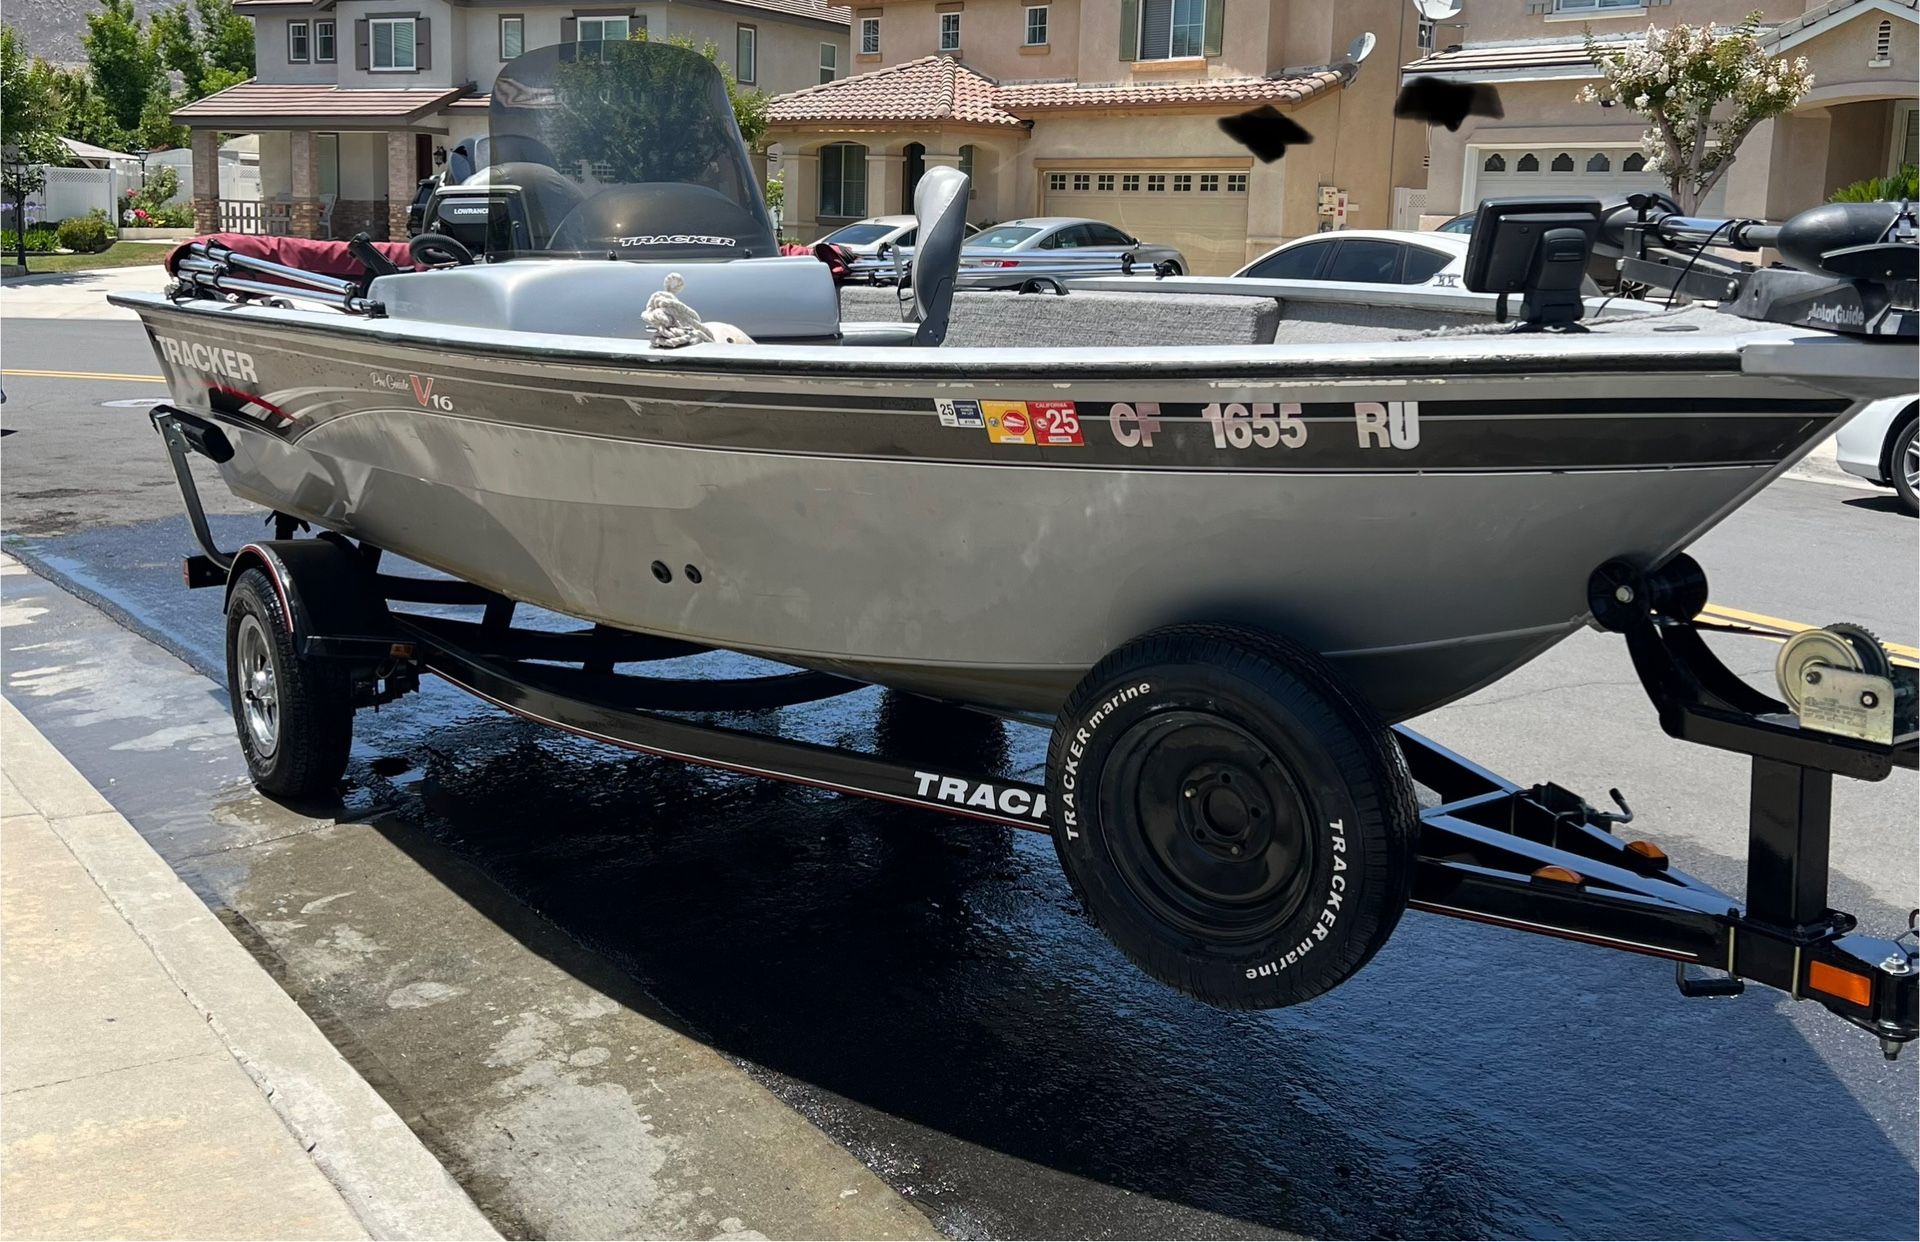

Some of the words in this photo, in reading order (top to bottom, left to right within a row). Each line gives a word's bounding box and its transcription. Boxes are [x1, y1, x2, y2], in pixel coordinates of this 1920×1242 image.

[619, 235, 736, 247] TRACKER
[155, 335, 259, 384] TRACKER
[939, 403, 954, 416] 25
[1046, 409, 1079, 434] 25
[1109, 402, 1161, 447] CF
[1201, 402, 1308, 449] 1655
[1354, 401, 1421, 450] RU
[1062, 727, 1091, 841] TRACKER
[1088, 682, 1150, 729] marine
[1311, 819, 1348, 941] TRACKER
[1245, 937, 1315, 980] marine
